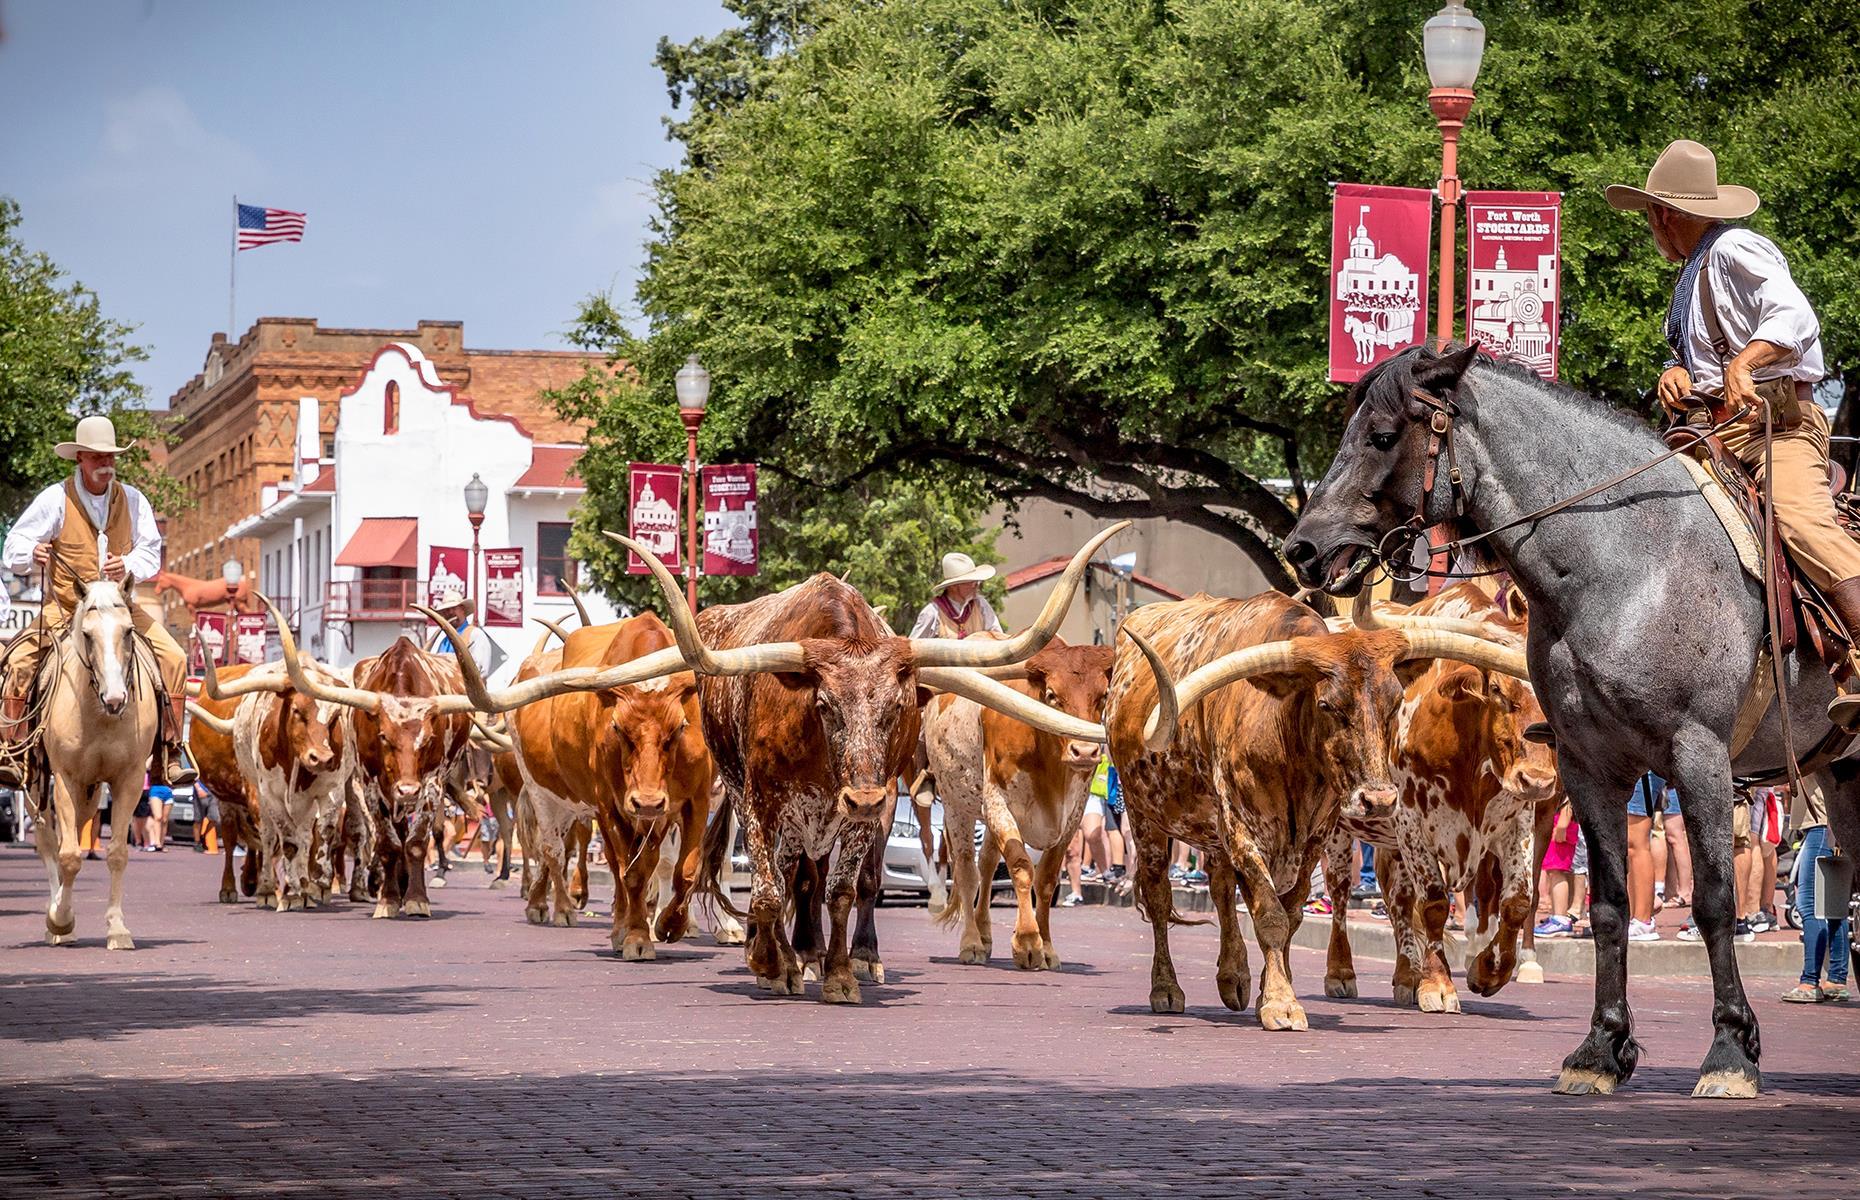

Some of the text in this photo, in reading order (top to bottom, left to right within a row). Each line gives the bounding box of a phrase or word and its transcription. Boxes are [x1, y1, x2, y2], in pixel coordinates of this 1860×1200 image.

[1487, 210, 1541, 222] Fort Worth
[1476, 222, 1550, 235] STOCKYARDS
[0, 609, 34, 629] RD
